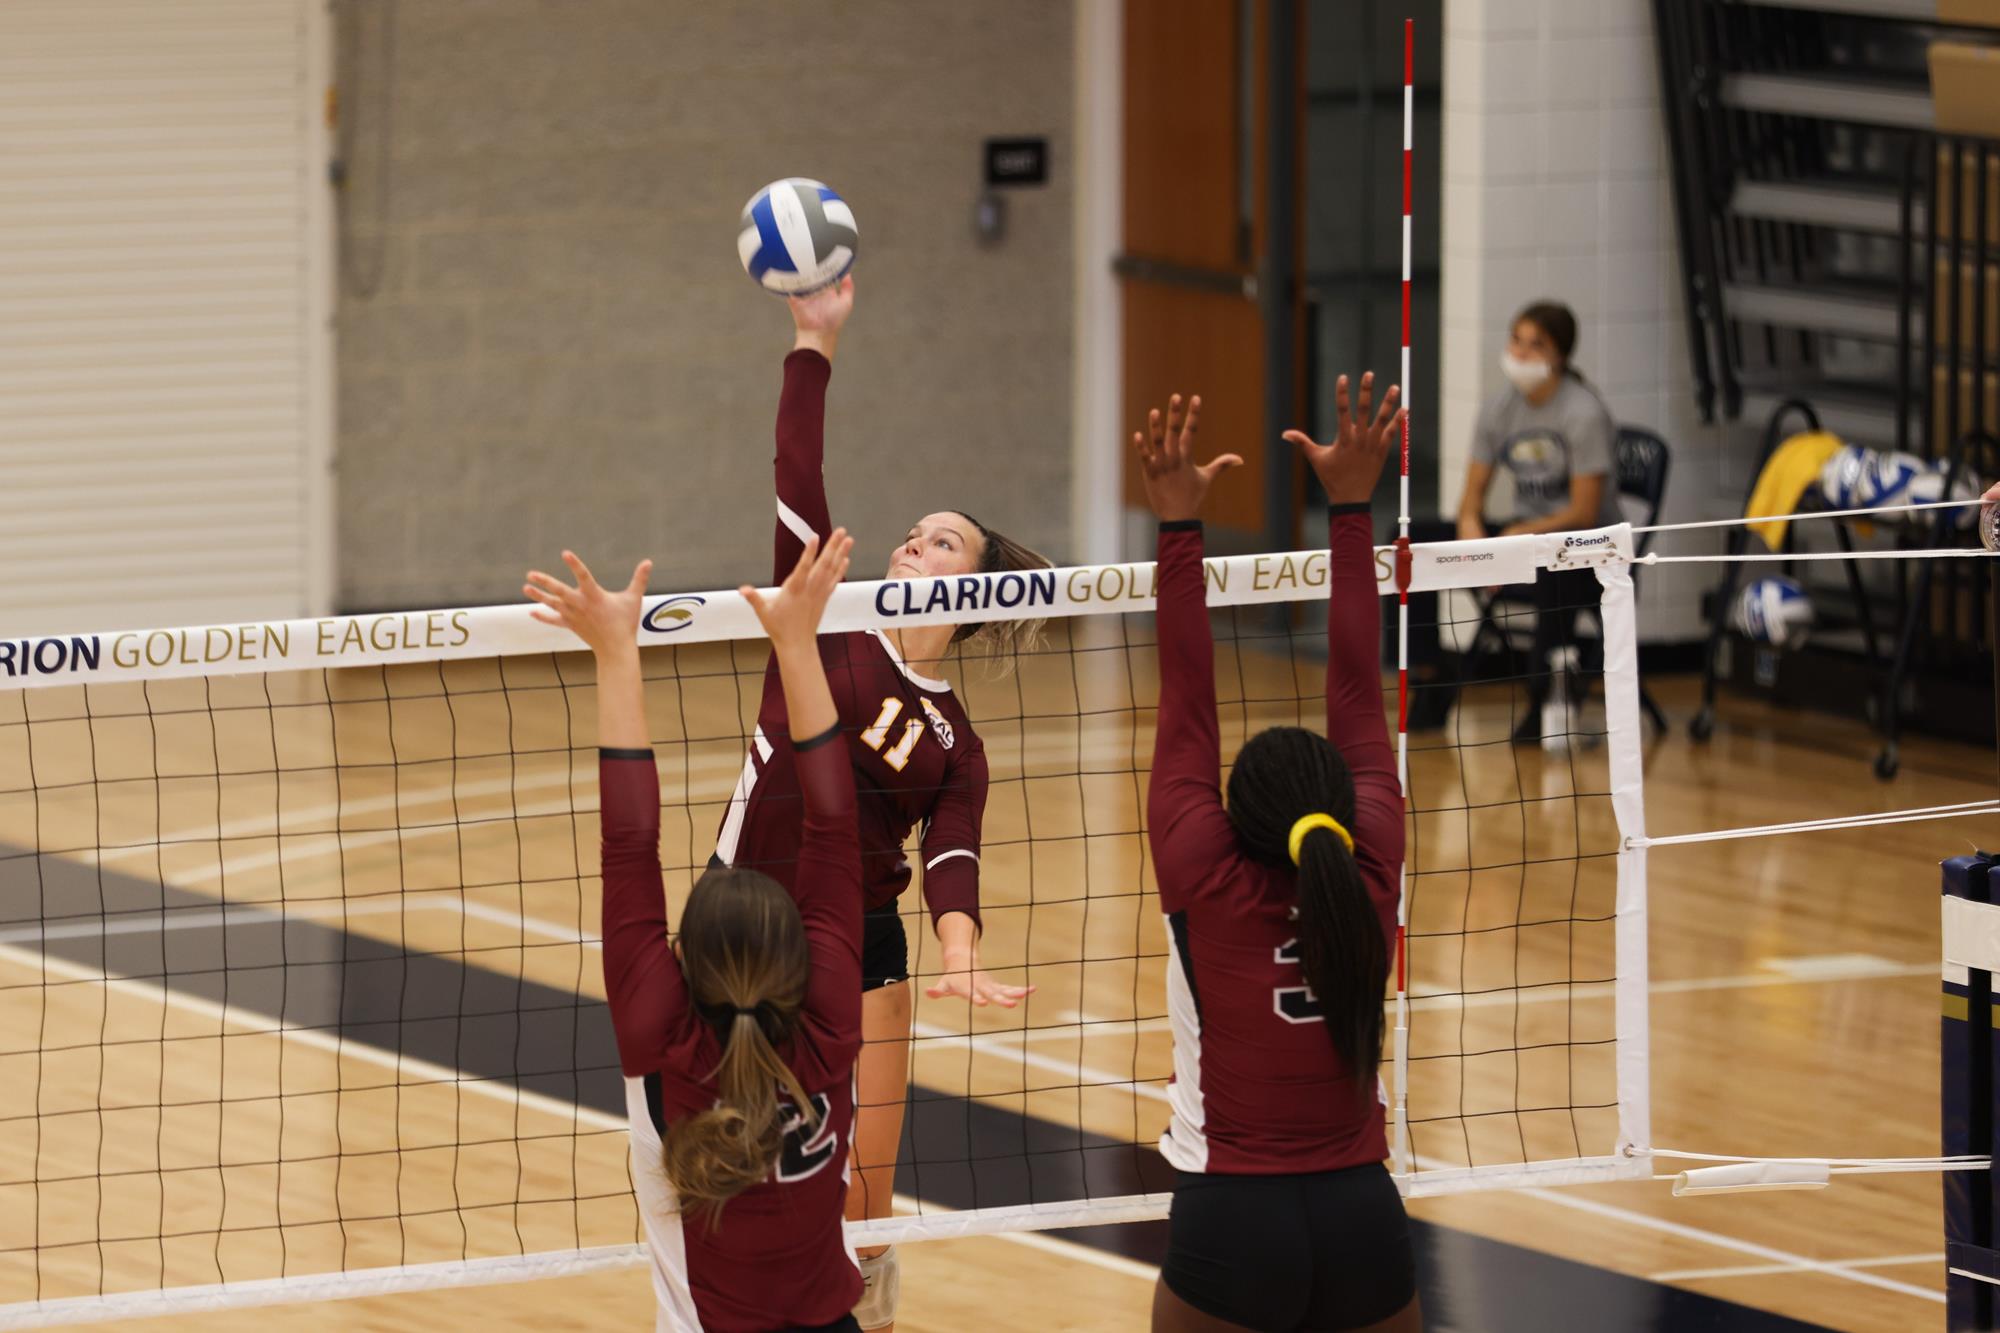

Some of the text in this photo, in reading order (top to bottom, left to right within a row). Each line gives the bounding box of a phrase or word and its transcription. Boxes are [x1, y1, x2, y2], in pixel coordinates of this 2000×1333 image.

[1575, 535, 1610, 547] Senoh
[875, 548, 1393, 616] CLARION GOLN EAGS
[112, 624, 289, 669] GOLDEN
[316, 611, 470, 656] EAGLES
[860, 697, 925, 772] 11
